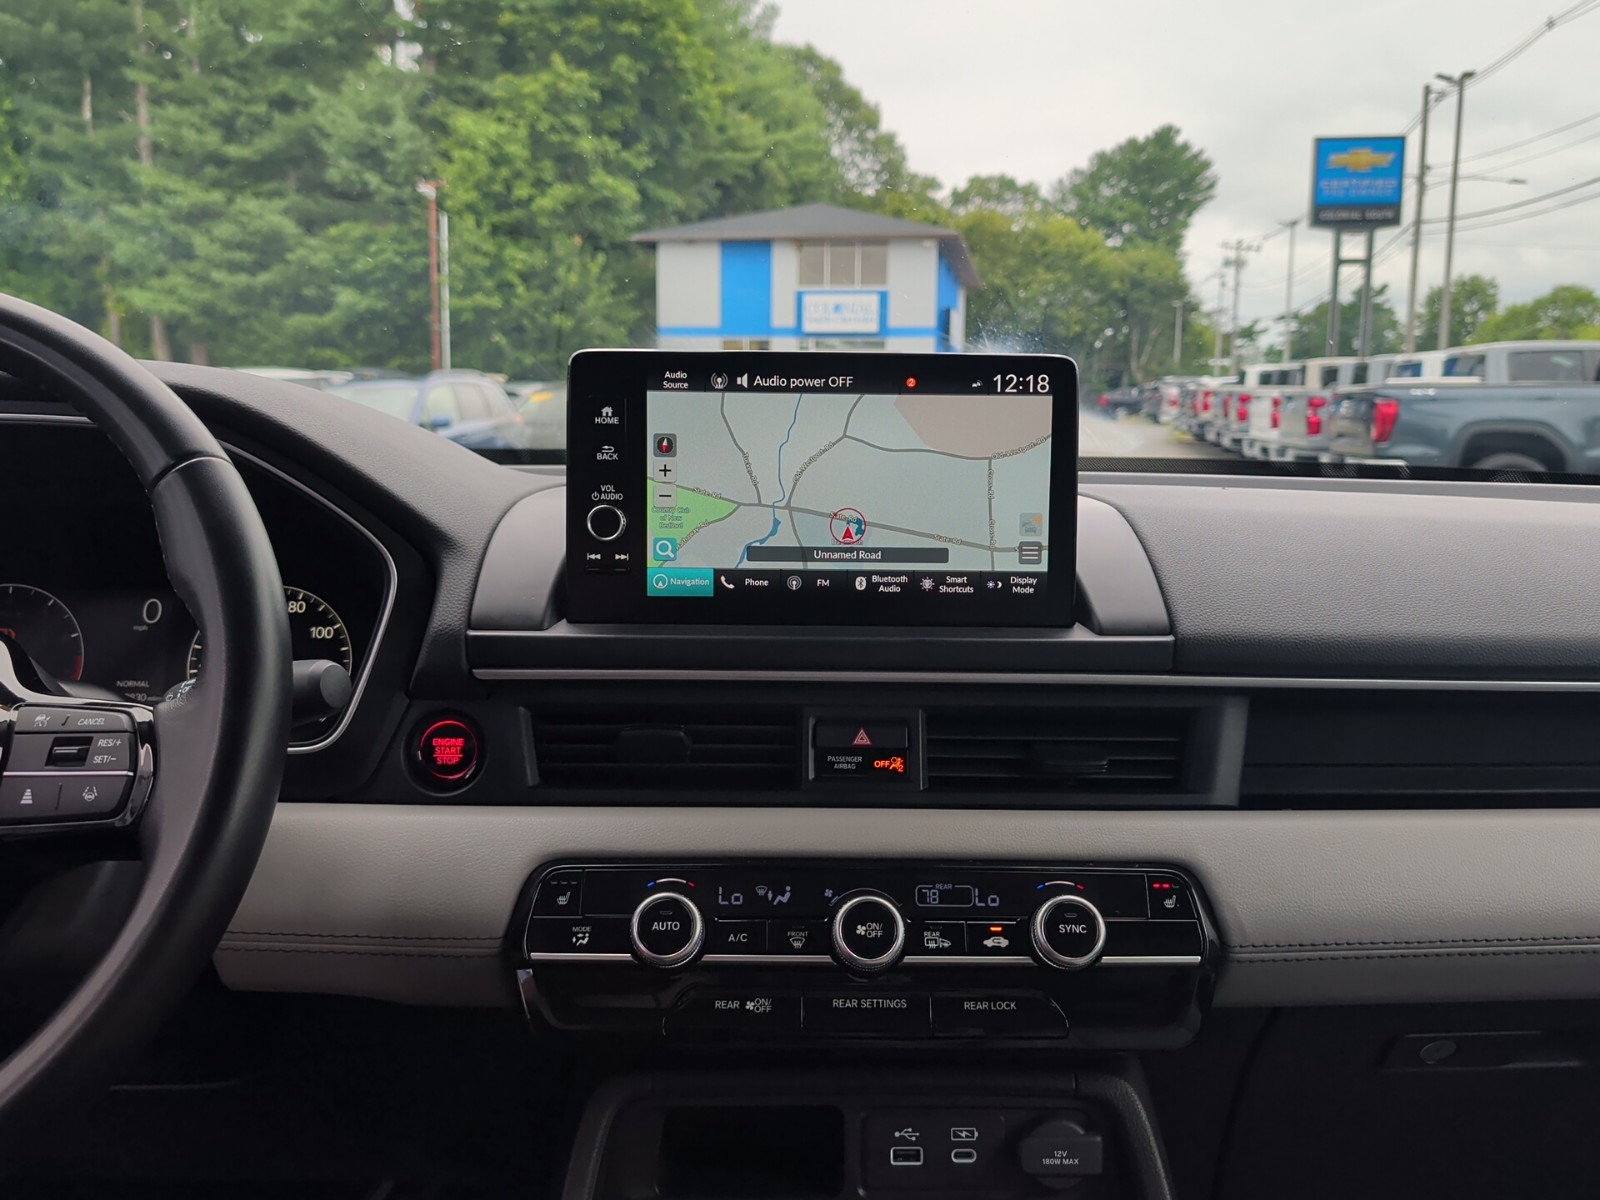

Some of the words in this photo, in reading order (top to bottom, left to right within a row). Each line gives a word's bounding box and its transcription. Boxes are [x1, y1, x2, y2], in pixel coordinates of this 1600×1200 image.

[664, 371, 688, 379] Audio
[663, 381, 689, 389] Source
[753, 375, 787, 387] Audio
[790, 377, 826, 389] power
[828, 376, 854, 387] OFF
[993, 374, 1050, 393] 12:18
[595, 417, 619, 425] HOME
[597, 452, 618, 460] BACK
[814, 551, 857, 560] Unnamed
[859, 551, 882, 560] Road
[670, 577, 710, 588] Navigation
[745, 577, 769, 586] Phone
[817, 579, 830, 587] FM
[871, 575, 908, 584] Bluetooth
[945, 576, 967, 584] Smart
[1010, 576, 1038, 587] Display
[878, 585, 901, 593] Audio
[939, 585, 974, 593] Shortcuts
[1012, 586, 1035, 594] Mode
[143, 598, 162, 624] 0
[287, 600, 306, 614] 80
[310, 626, 334, 639] 100
[116, 680, 150, 688] NORMAL
[77, 717, 105, 726] CANCEL
[98, 738, 122, 748] RES/+
[432, 738, 464, 746] ENGINE
[435, 746, 461, 754] START
[874, 760, 890, 768] OFF
[718, 886, 743, 905] Lo
[921, 889, 939, 904] 78
[975, 888, 1000, 907] Lo
[652, 921, 680, 931] AUTO
[866, 923, 883, 931] ON/
[1058, 924, 1087, 934] SYNC
[728, 933, 748, 942] A/C
[714, 1001, 740, 1010] REAR
[754, 998, 772, 1006] ON/
[832, 1000, 858, 1008] REAR
[860, 1000, 907, 1008] SETTINGS
[964, 1001, 989, 1010] REAR
[991, 1001, 1017, 1010] LOCK
